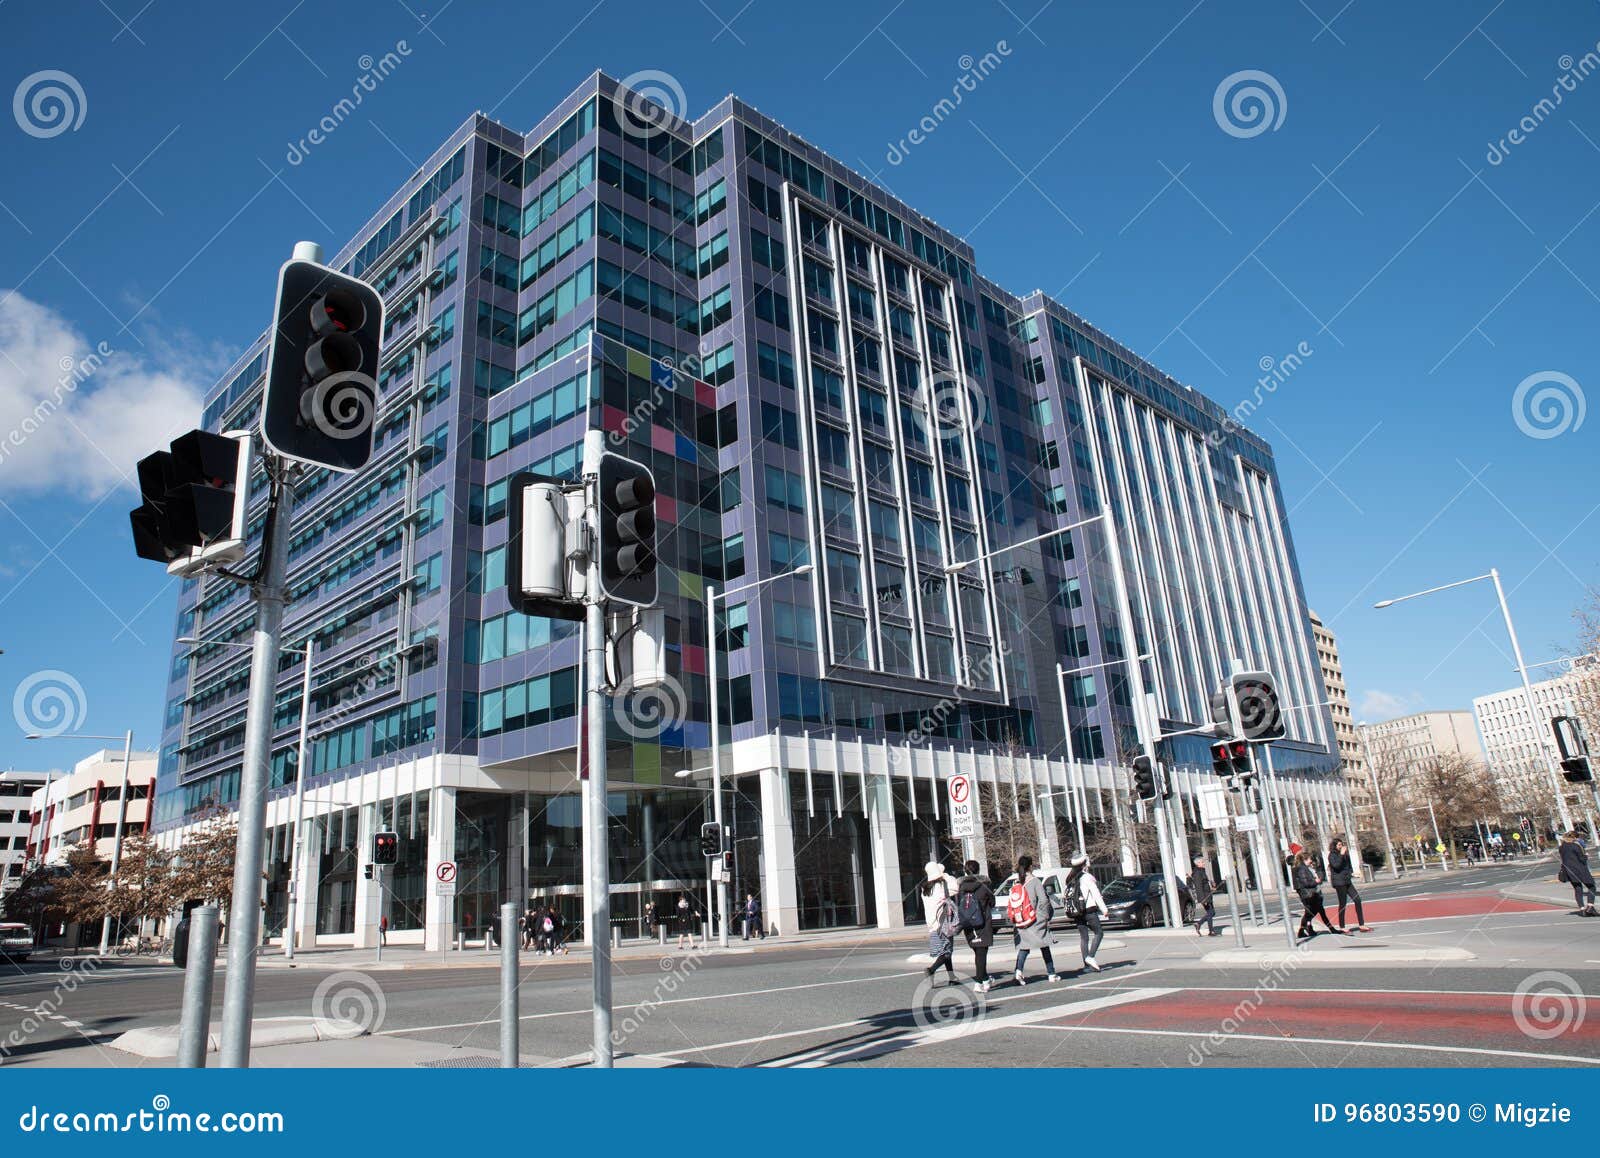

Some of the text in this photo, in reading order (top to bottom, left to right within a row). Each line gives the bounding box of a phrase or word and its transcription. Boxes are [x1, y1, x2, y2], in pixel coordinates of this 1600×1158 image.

[955, 805, 968, 815] NO
[954, 816, 971, 824] RIGHT
[955, 826, 972, 834] TURN
